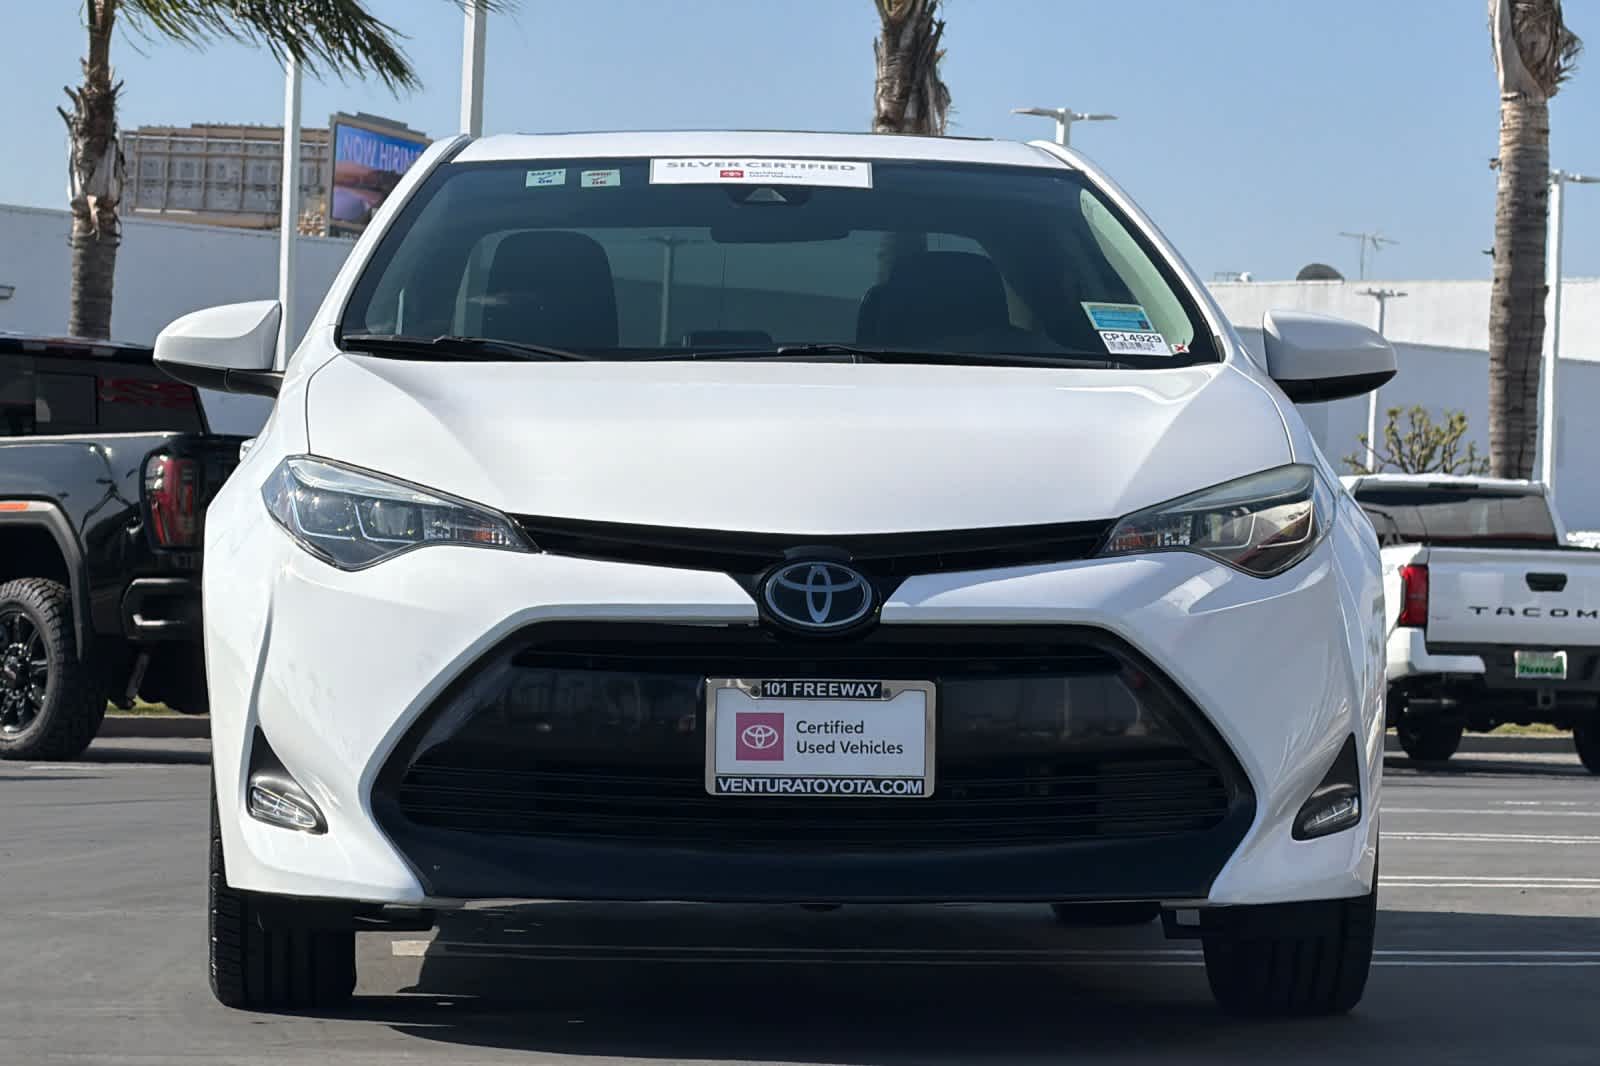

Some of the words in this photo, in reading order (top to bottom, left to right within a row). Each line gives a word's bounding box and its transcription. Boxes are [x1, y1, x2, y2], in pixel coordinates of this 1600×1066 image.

[343, 134, 378, 168] NOW
[380, 141, 421, 176] HIRIN
[745, 161, 857, 171] CERTIFIED
[1103, 332, 1162, 343] CP14929
[764, 682, 787, 696] 101
[792, 682, 878, 697] FREEWAY
[796, 720, 864, 735] Certified
[796, 740, 835, 754] Used
[840, 740, 904, 754] Vehicles
[718, 778, 923, 794] VENTURATOYOTA.COM
